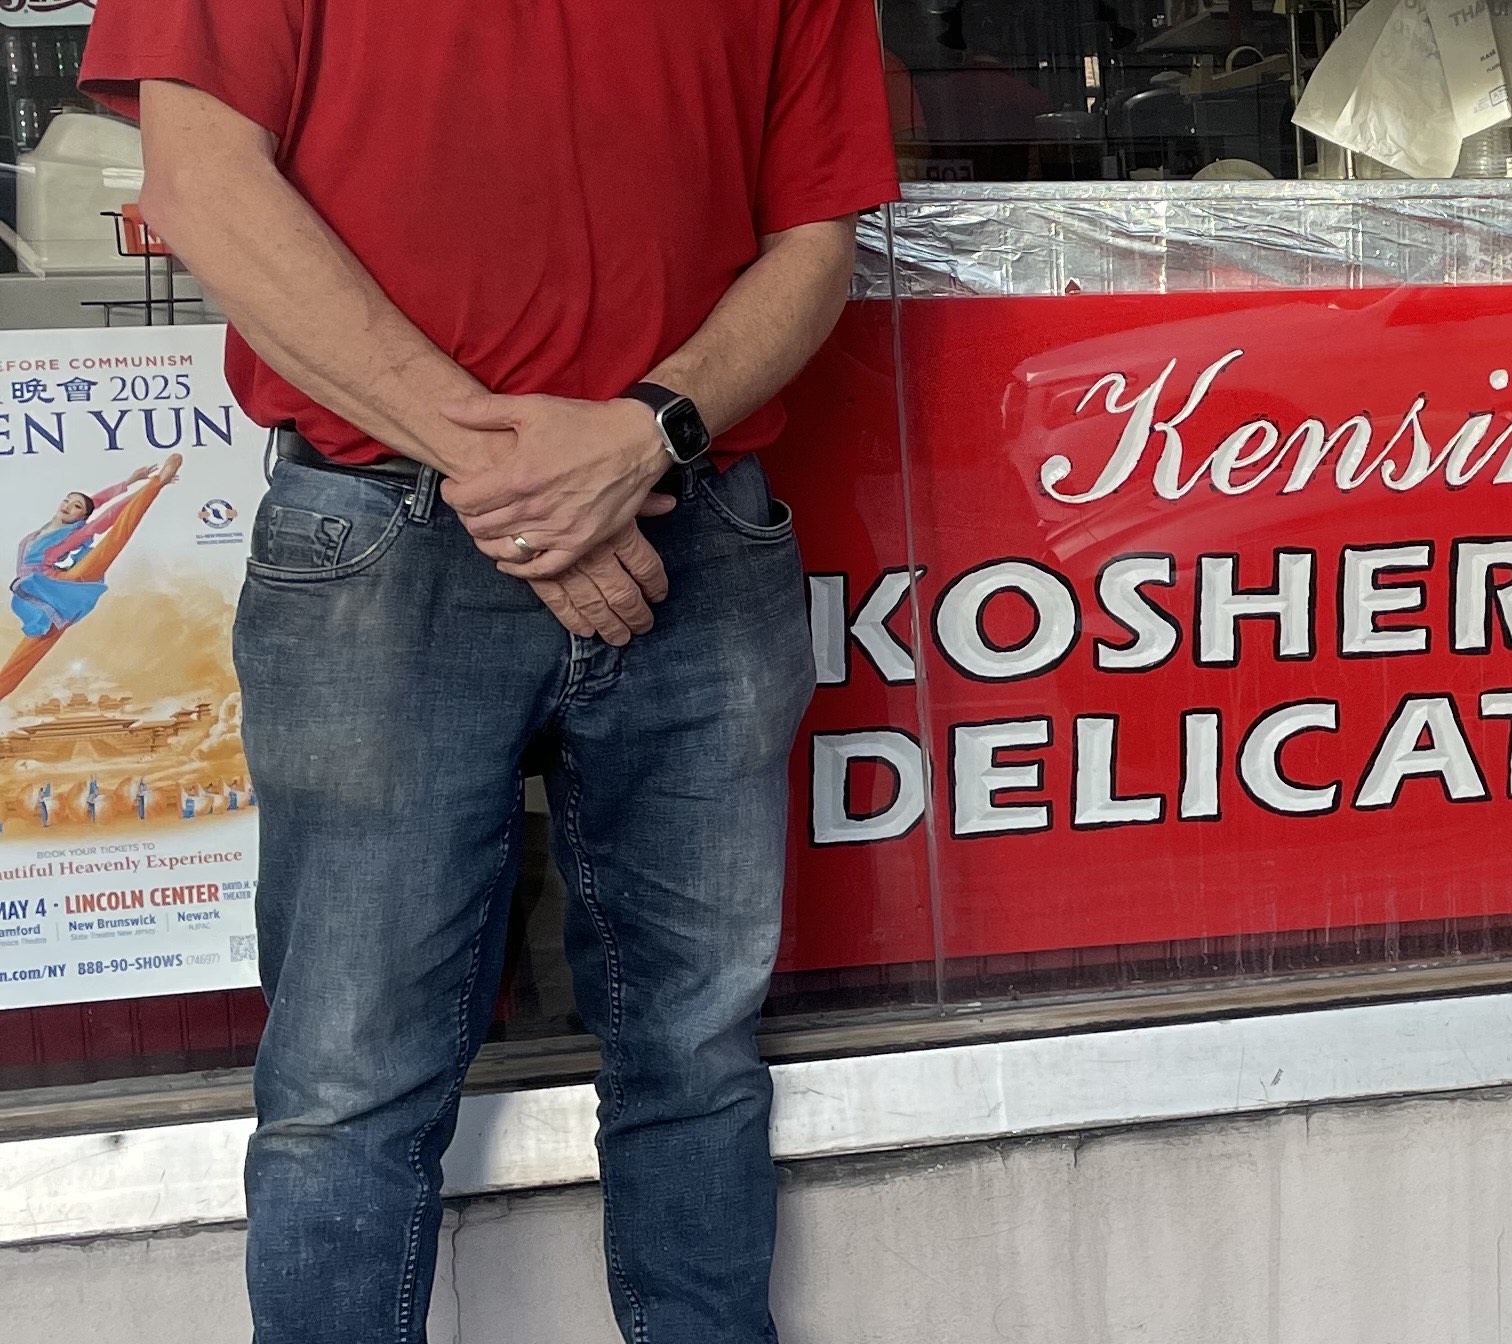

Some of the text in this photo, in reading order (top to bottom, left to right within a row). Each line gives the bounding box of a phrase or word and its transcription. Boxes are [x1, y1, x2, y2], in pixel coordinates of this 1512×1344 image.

[69, 355, 193, 369] COMMUNISM
[109, 374, 191, 402] 2025
[87, 405, 234, 451] YUN
[37, 842, 155, 859] BOOK YOUR TICKETS TO
[59, 856, 140, 873] Heavenly
[146, 850, 243, 870] Experience
[35, 898, 47, 917] 4
[65, 890, 144, 914] LINCOLN
[150, 883, 220, 907] CENTER
[69, 914, 156, 931] New Brunswick
[177, 909, 220, 922] Newark
[78, 954, 183, 975] 888-90-SHOWS
